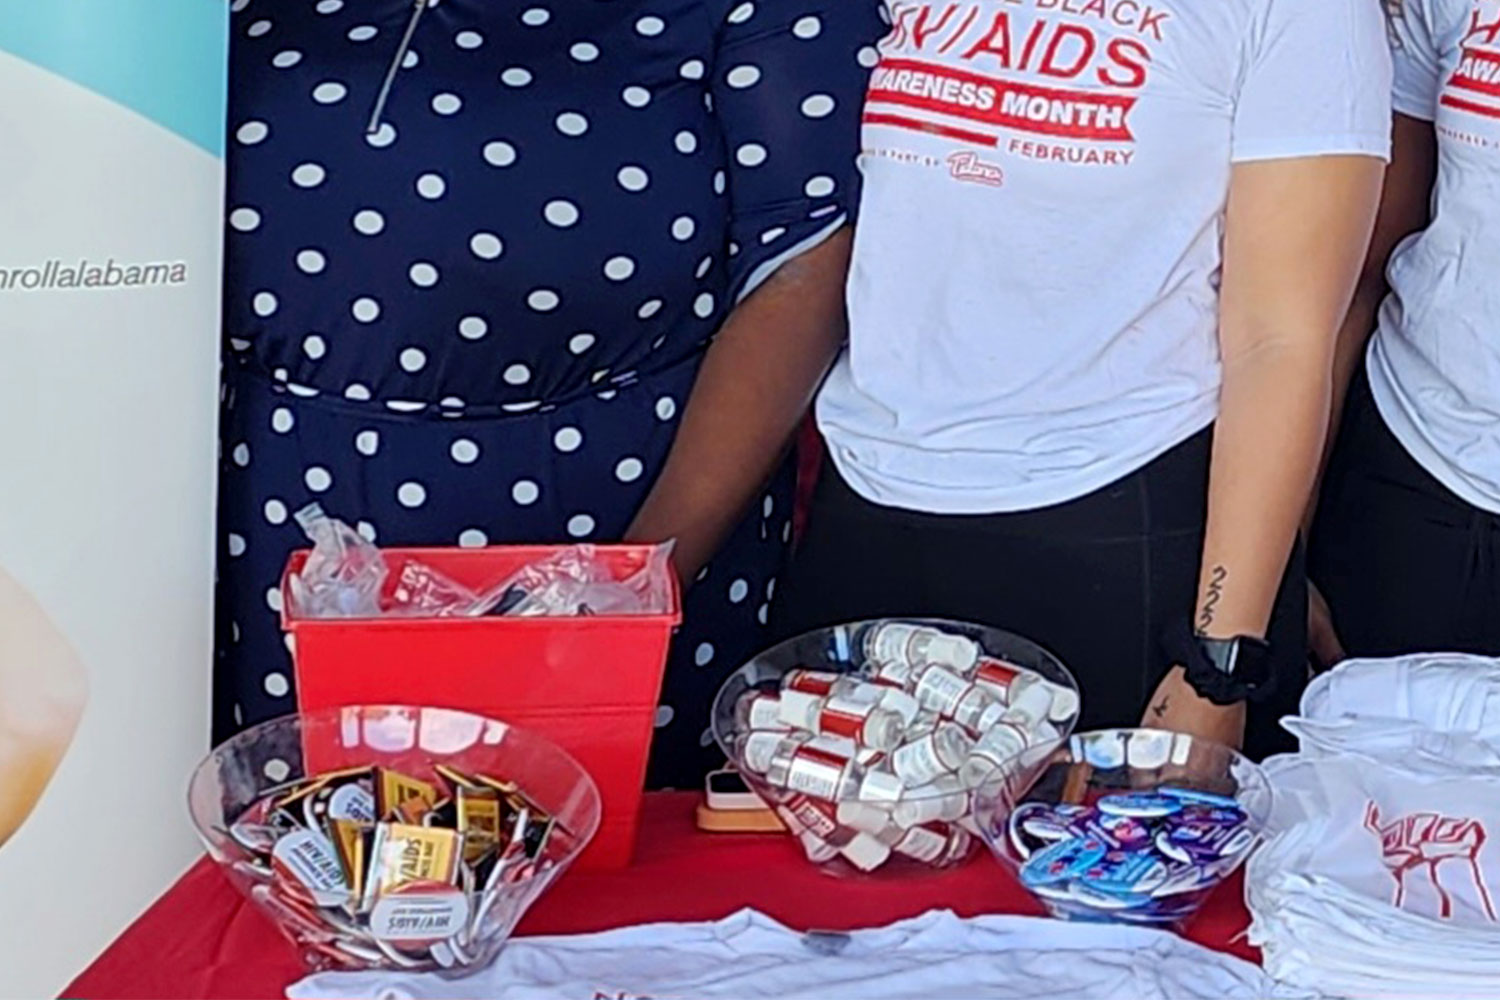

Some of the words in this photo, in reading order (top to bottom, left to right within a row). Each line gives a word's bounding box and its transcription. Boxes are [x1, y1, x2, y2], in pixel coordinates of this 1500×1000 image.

[871, 66, 995, 110] ARENESS
[1000, 93, 1124, 130] MONTH
[1008, 138, 1135, 166] FEBRUARY
[387, 915, 451, 930] HIV/AIDS
